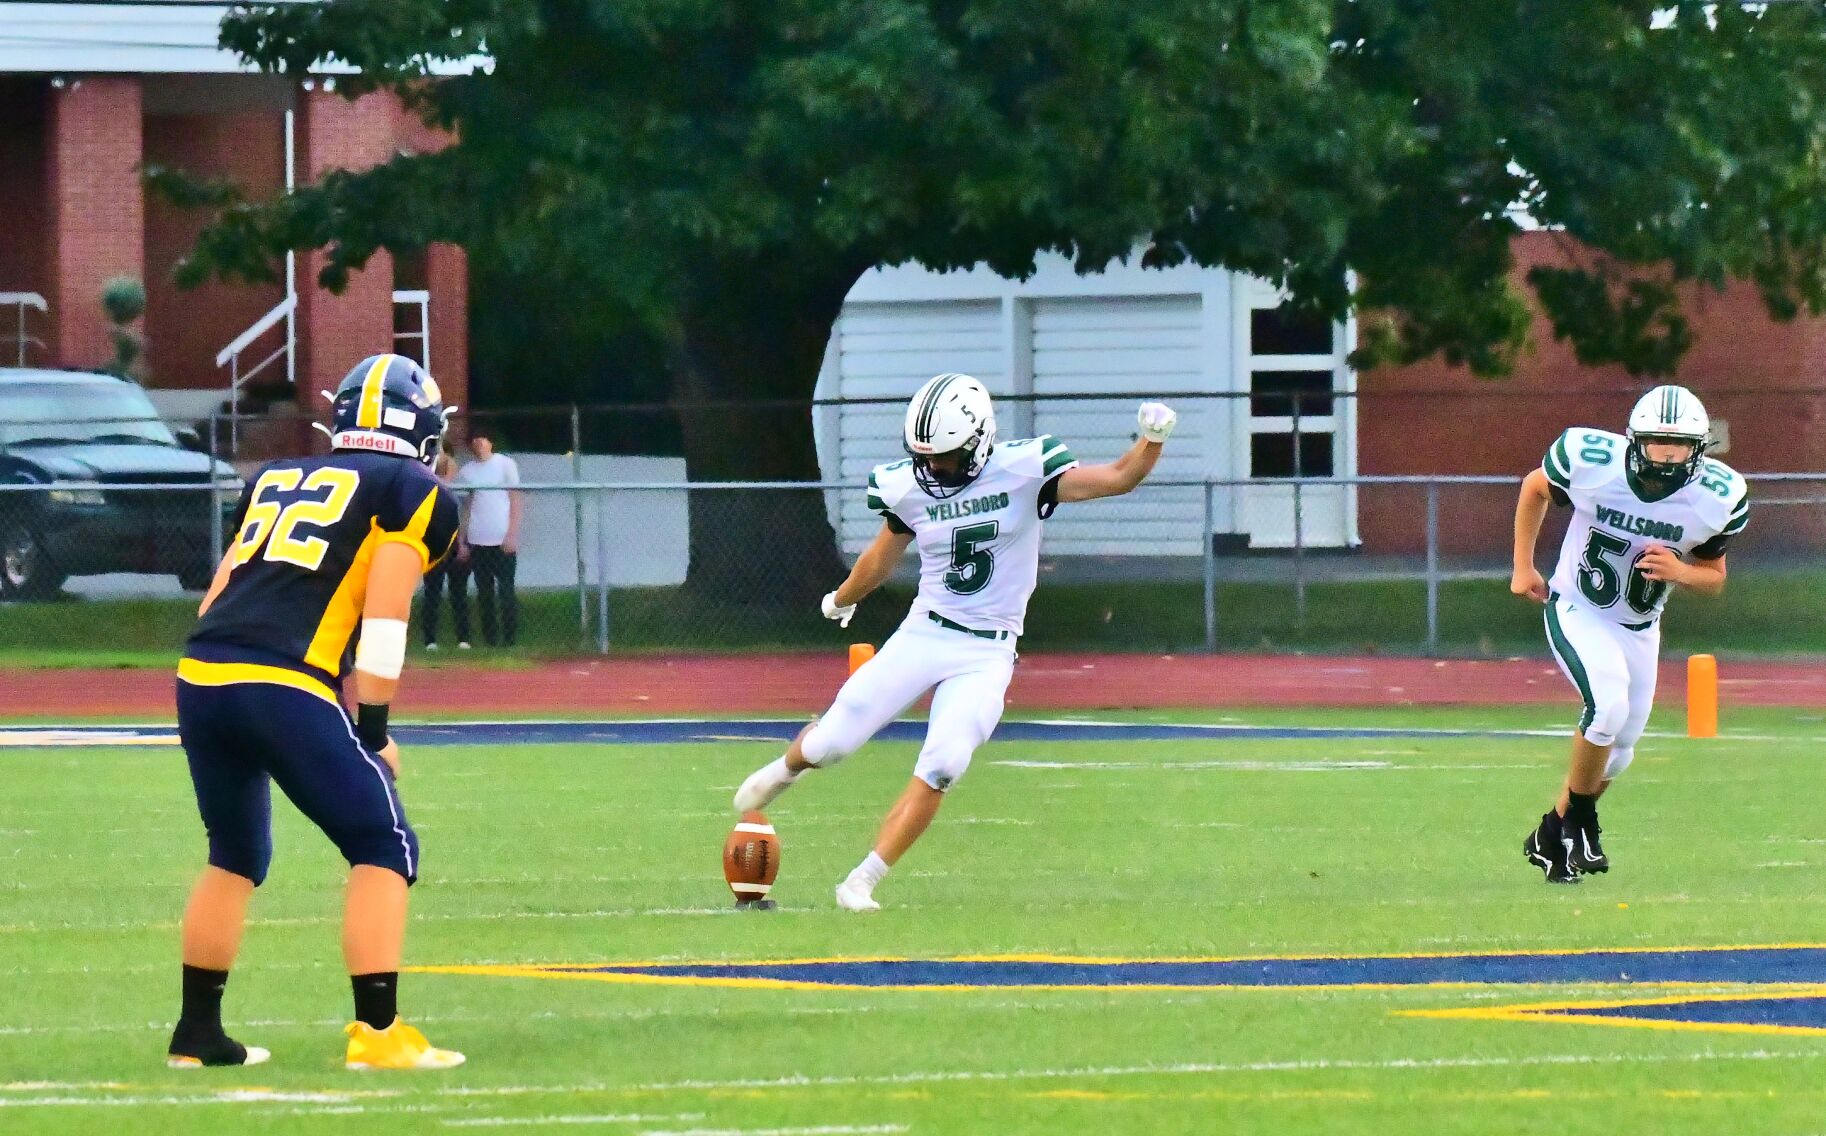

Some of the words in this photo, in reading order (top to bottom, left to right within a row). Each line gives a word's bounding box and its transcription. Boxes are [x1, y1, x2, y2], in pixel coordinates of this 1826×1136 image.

[342, 434, 395, 452] Riddell
[1579, 432, 1615, 467] 50
[231, 466, 360, 571] 62
[925, 491, 1010, 522] WELLSBORO
[1595, 503, 1684, 543] WELLSBORO
[942, 519, 999, 596] 5
